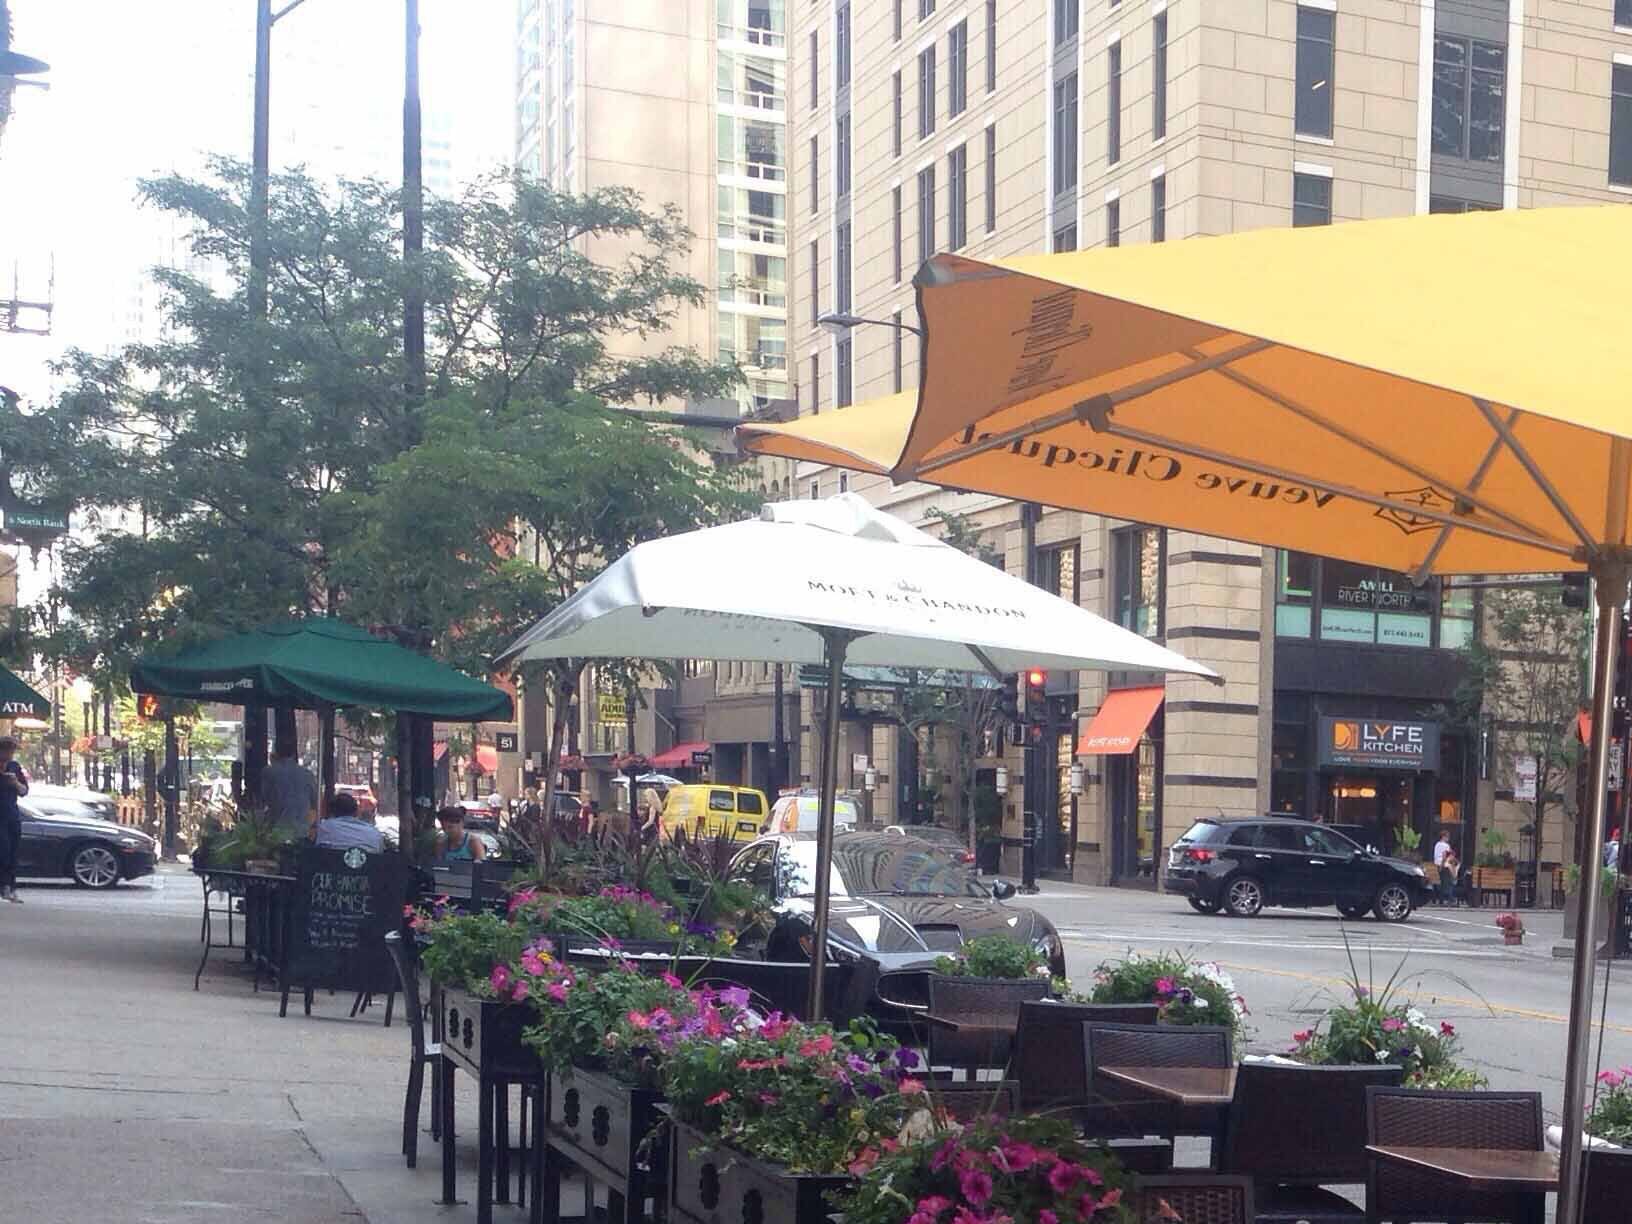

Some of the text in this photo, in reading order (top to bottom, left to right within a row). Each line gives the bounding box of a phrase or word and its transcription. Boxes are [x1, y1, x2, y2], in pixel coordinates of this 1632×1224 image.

[1338, 590, 1369, 603] RIVER
[2, 701, 34, 714] ATM
[1363, 723, 1423, 742] LYFE
[1363, 741, 1423, 753] KITCHEN
[311, 891, 374, 914] PROMISE
